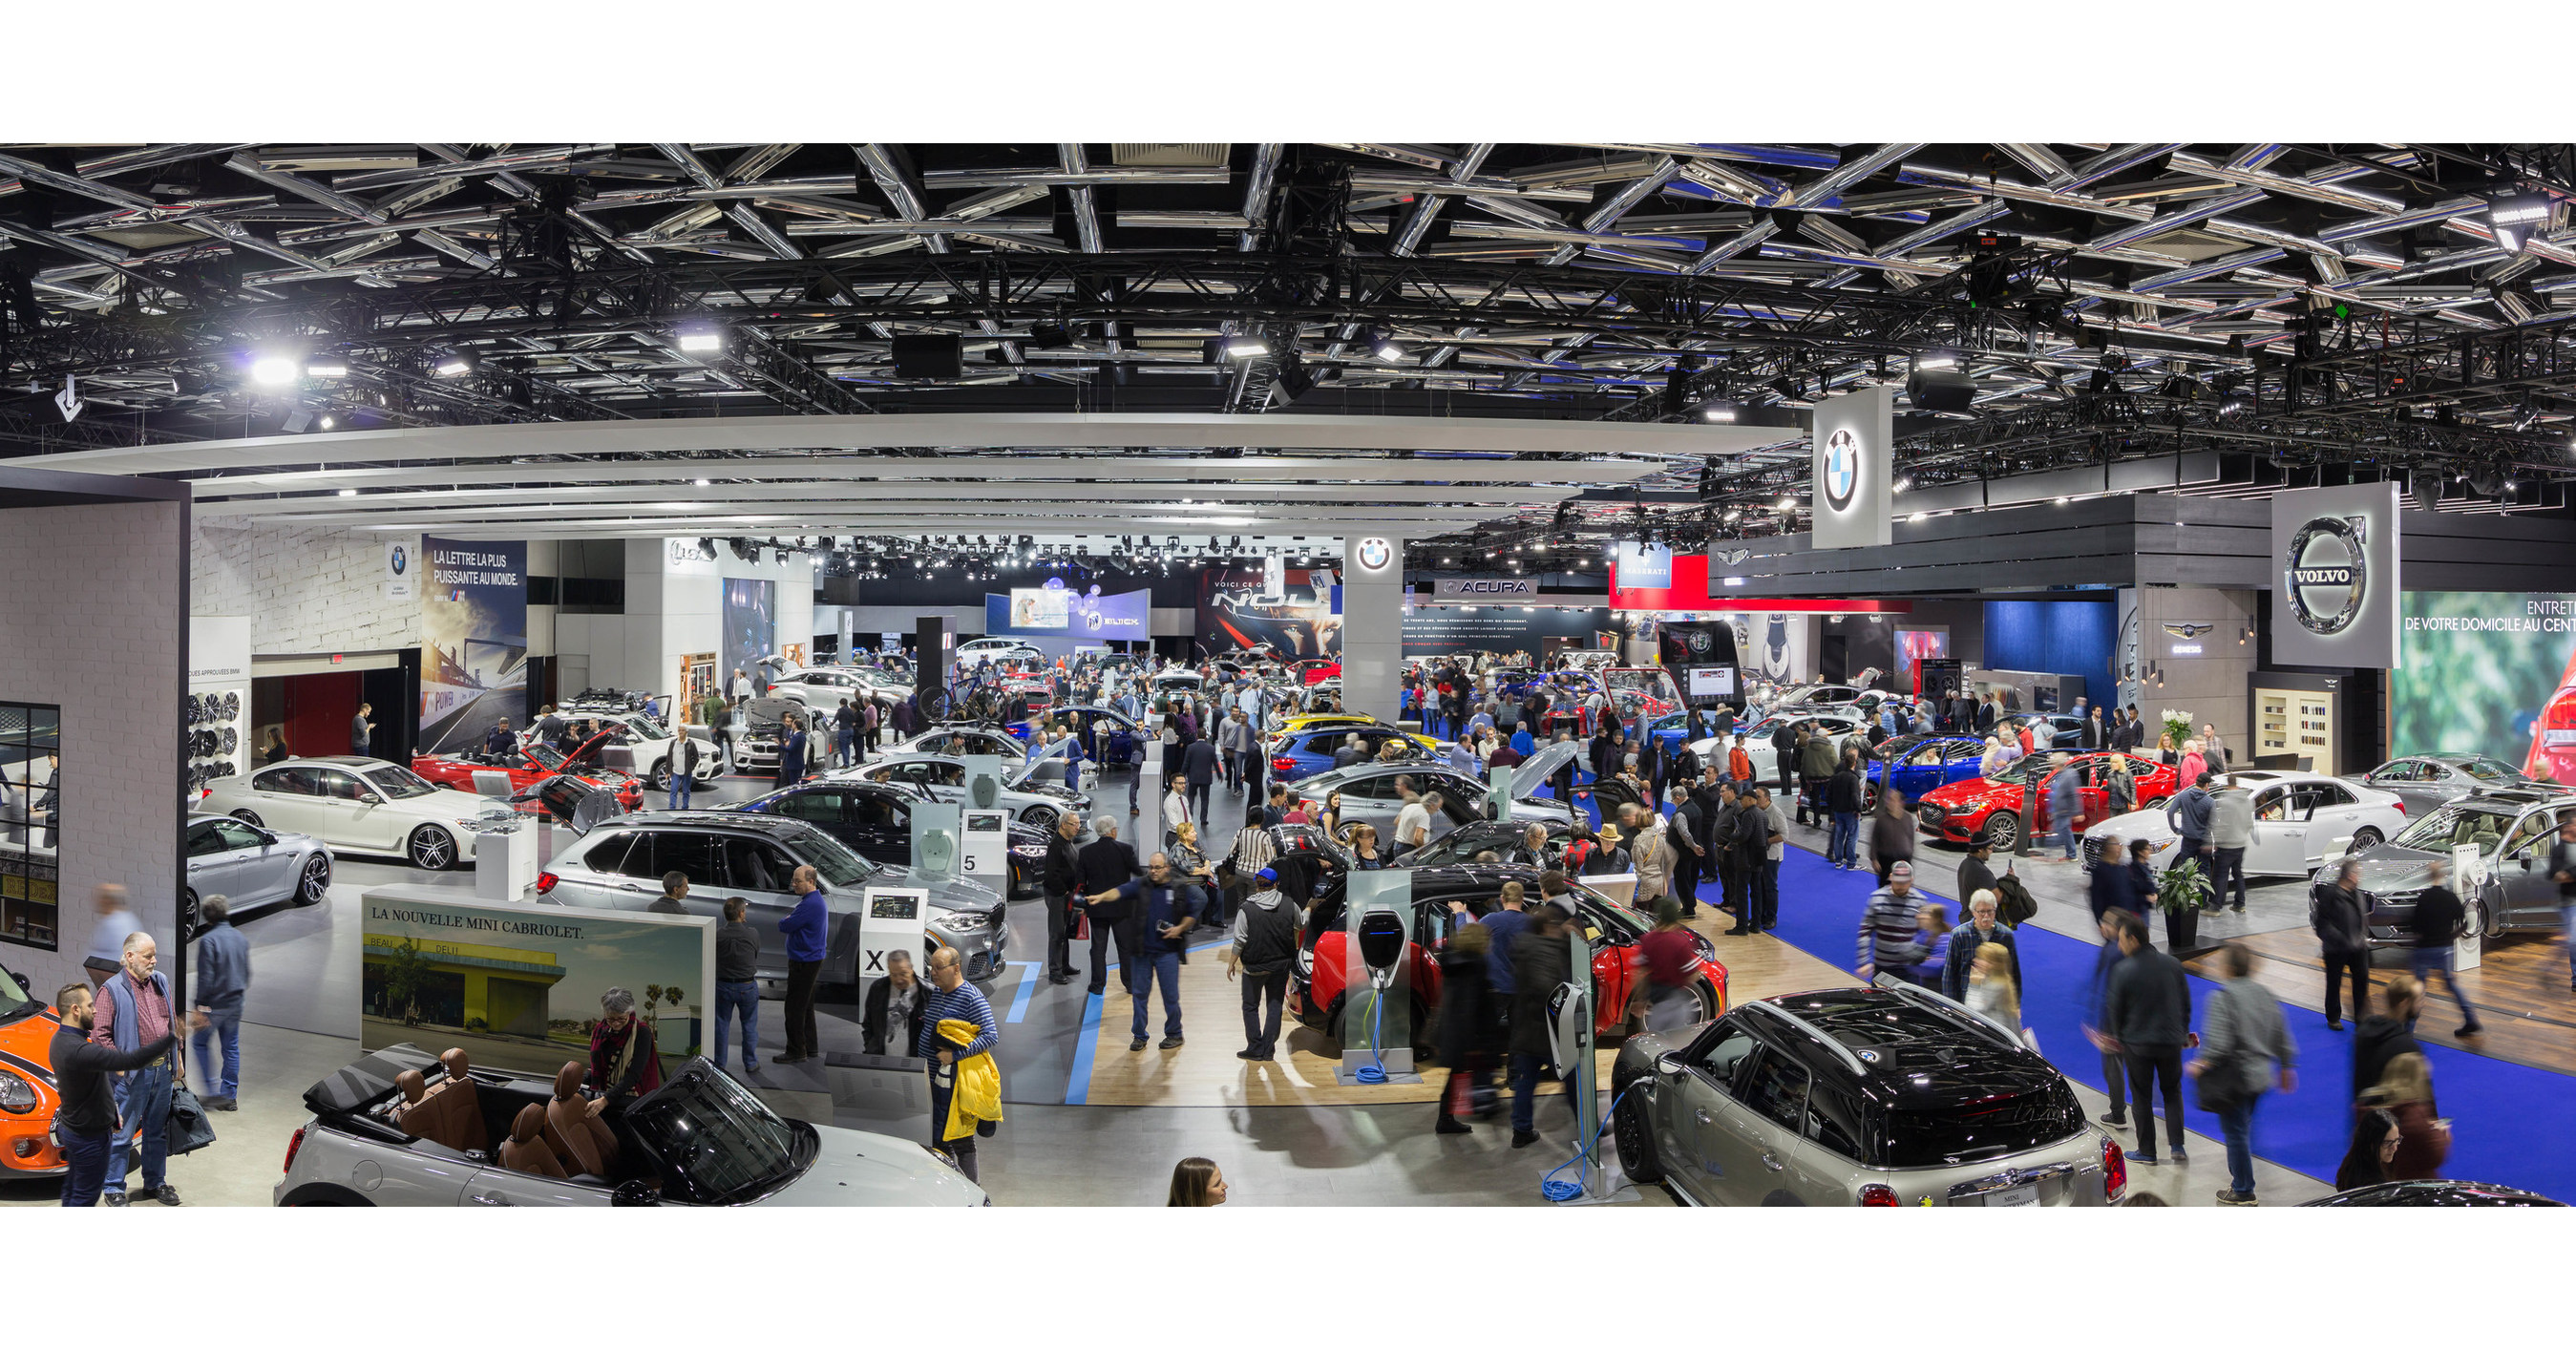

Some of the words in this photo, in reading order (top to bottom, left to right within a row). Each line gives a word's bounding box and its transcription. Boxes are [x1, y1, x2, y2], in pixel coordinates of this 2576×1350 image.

[433, 549, 444, 563] LA
[446, 551, 475, 566] LETTRE
[477, 553, 487, 566] LA
[488, 554, 507, 567] PLUS
[433, 570, 478, 584] PUISSANTE
[479, 571, 490, 584] AU
[491, 572, 517, 585] MONDE.
[1625, 567, 1667, 576] MASERATI
[2294, 569, 2350, 582] VOLVO
[1459, 580, 1530, 592] ACURA
[2405, 618, 2419, 630] DE
[2421, 618, 2459, 631] VOTRE
[2461, 618, 2521, 631] DOMICILE
[2523, 618, 2540, 632] AU
[436, 691, 454, 711] POWER
[964, 855, 975, 871] 5
[372, 907, 389, 919] LA
[392, 909, 462, 928] NOUVELLE
[466, 917, 498, 931] MINI
[502, 920, 584, 939] CABRIOLET.
[370, 938, 393, 947] BEAU
[865, 949, 884, 971] X
[2004, 1194, 2020, 1203] MINI
